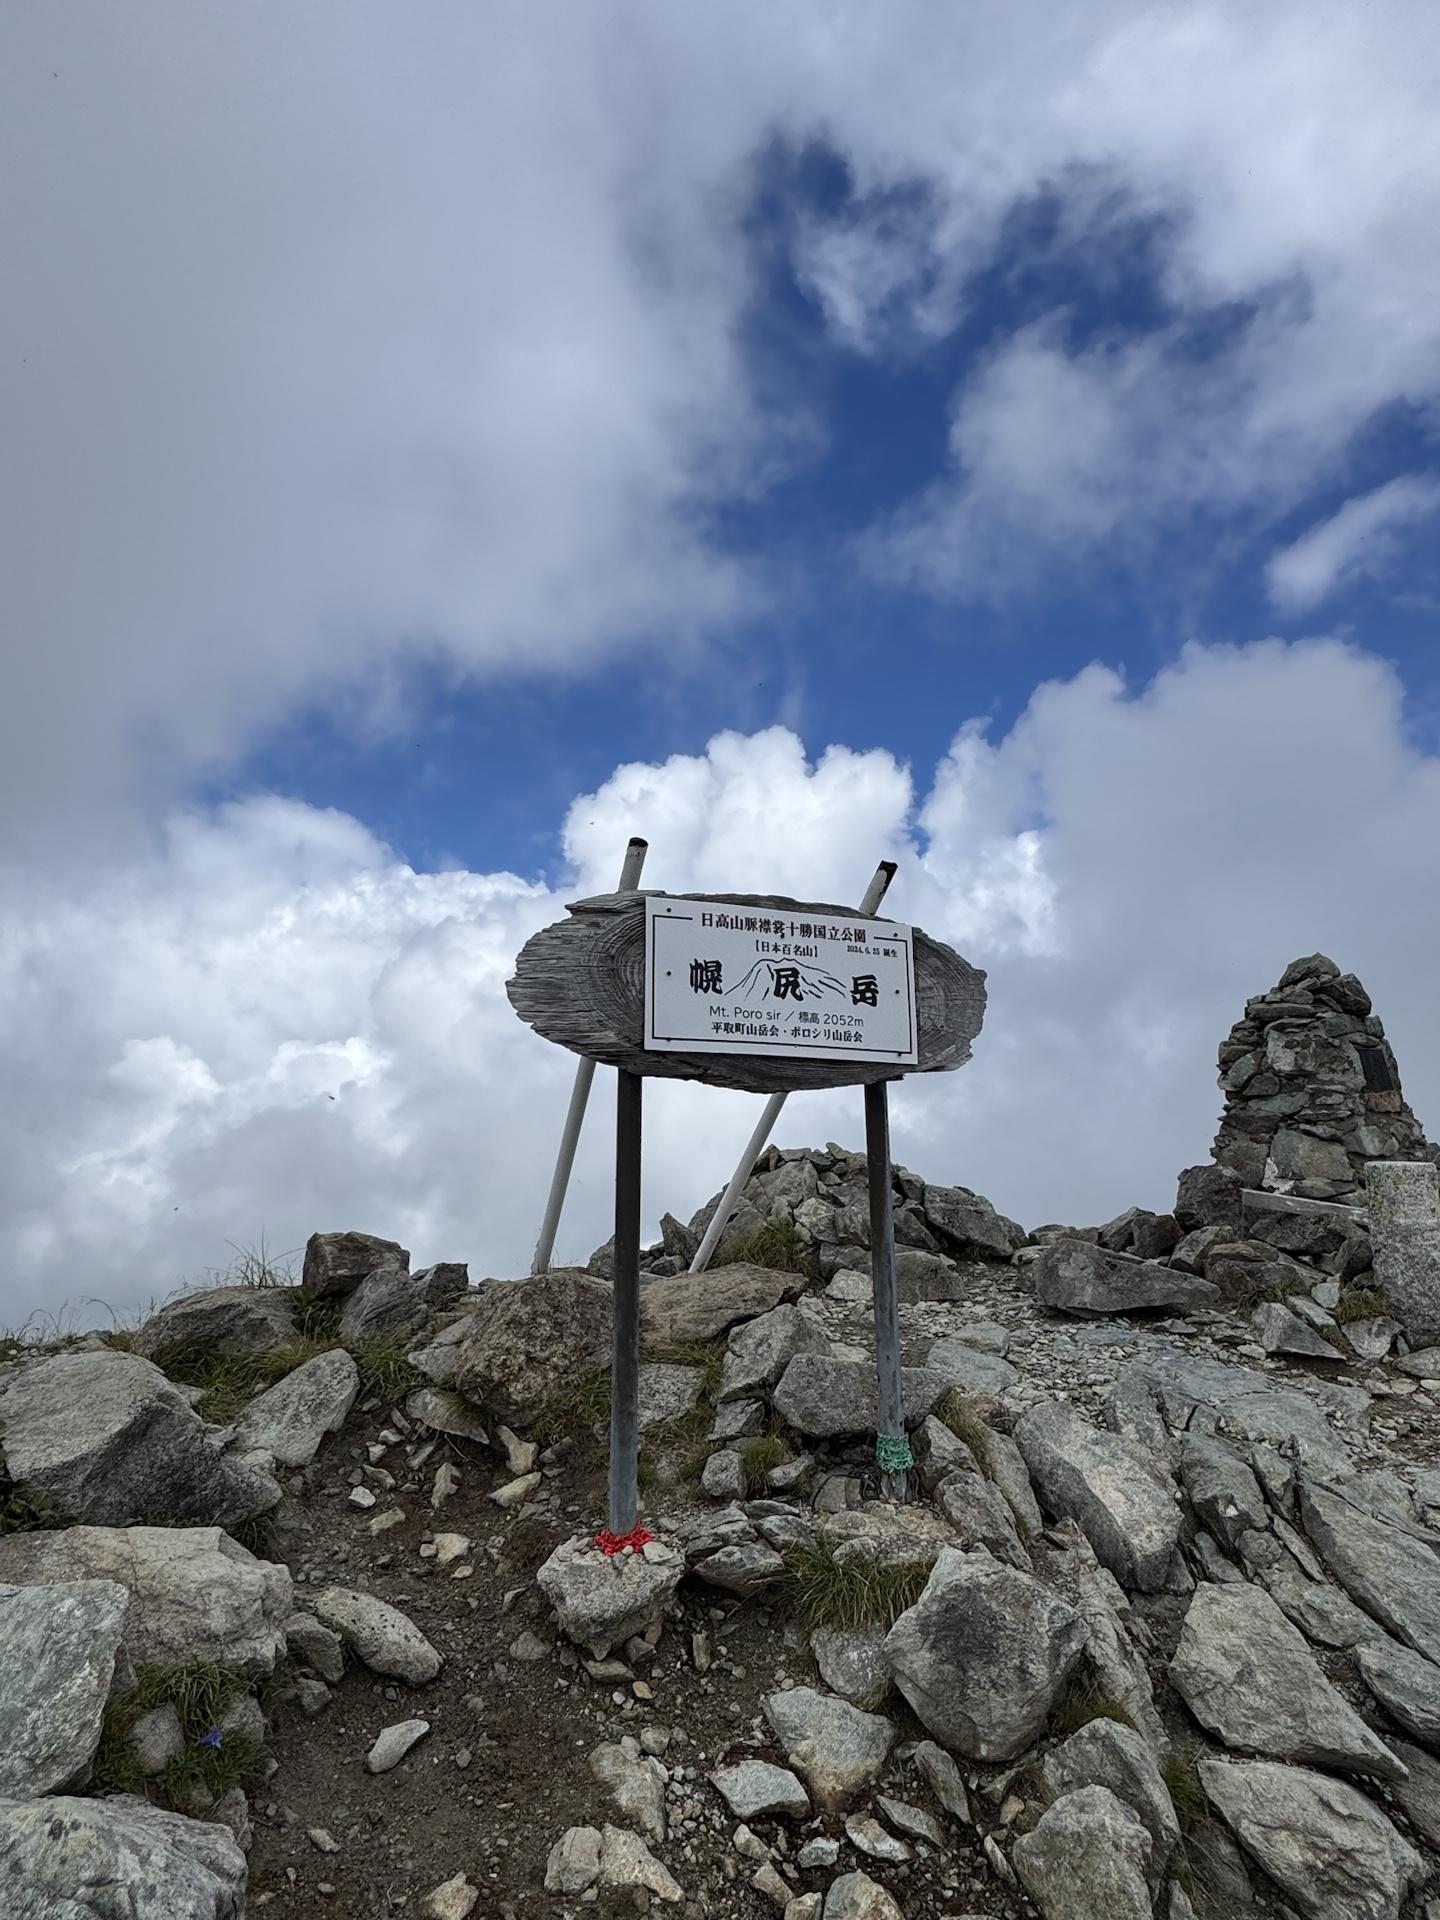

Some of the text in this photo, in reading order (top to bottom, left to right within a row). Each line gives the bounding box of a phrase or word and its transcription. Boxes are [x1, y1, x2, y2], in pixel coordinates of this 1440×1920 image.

[709, 1005, 730, 1017] Mt.
[734, 1006, 763, 1019] Poro
[766, 1009, 781, 1020] sir
[798, 1011, 820, 1025] 標高
[823, 1013, 864, 1027] 2052m
